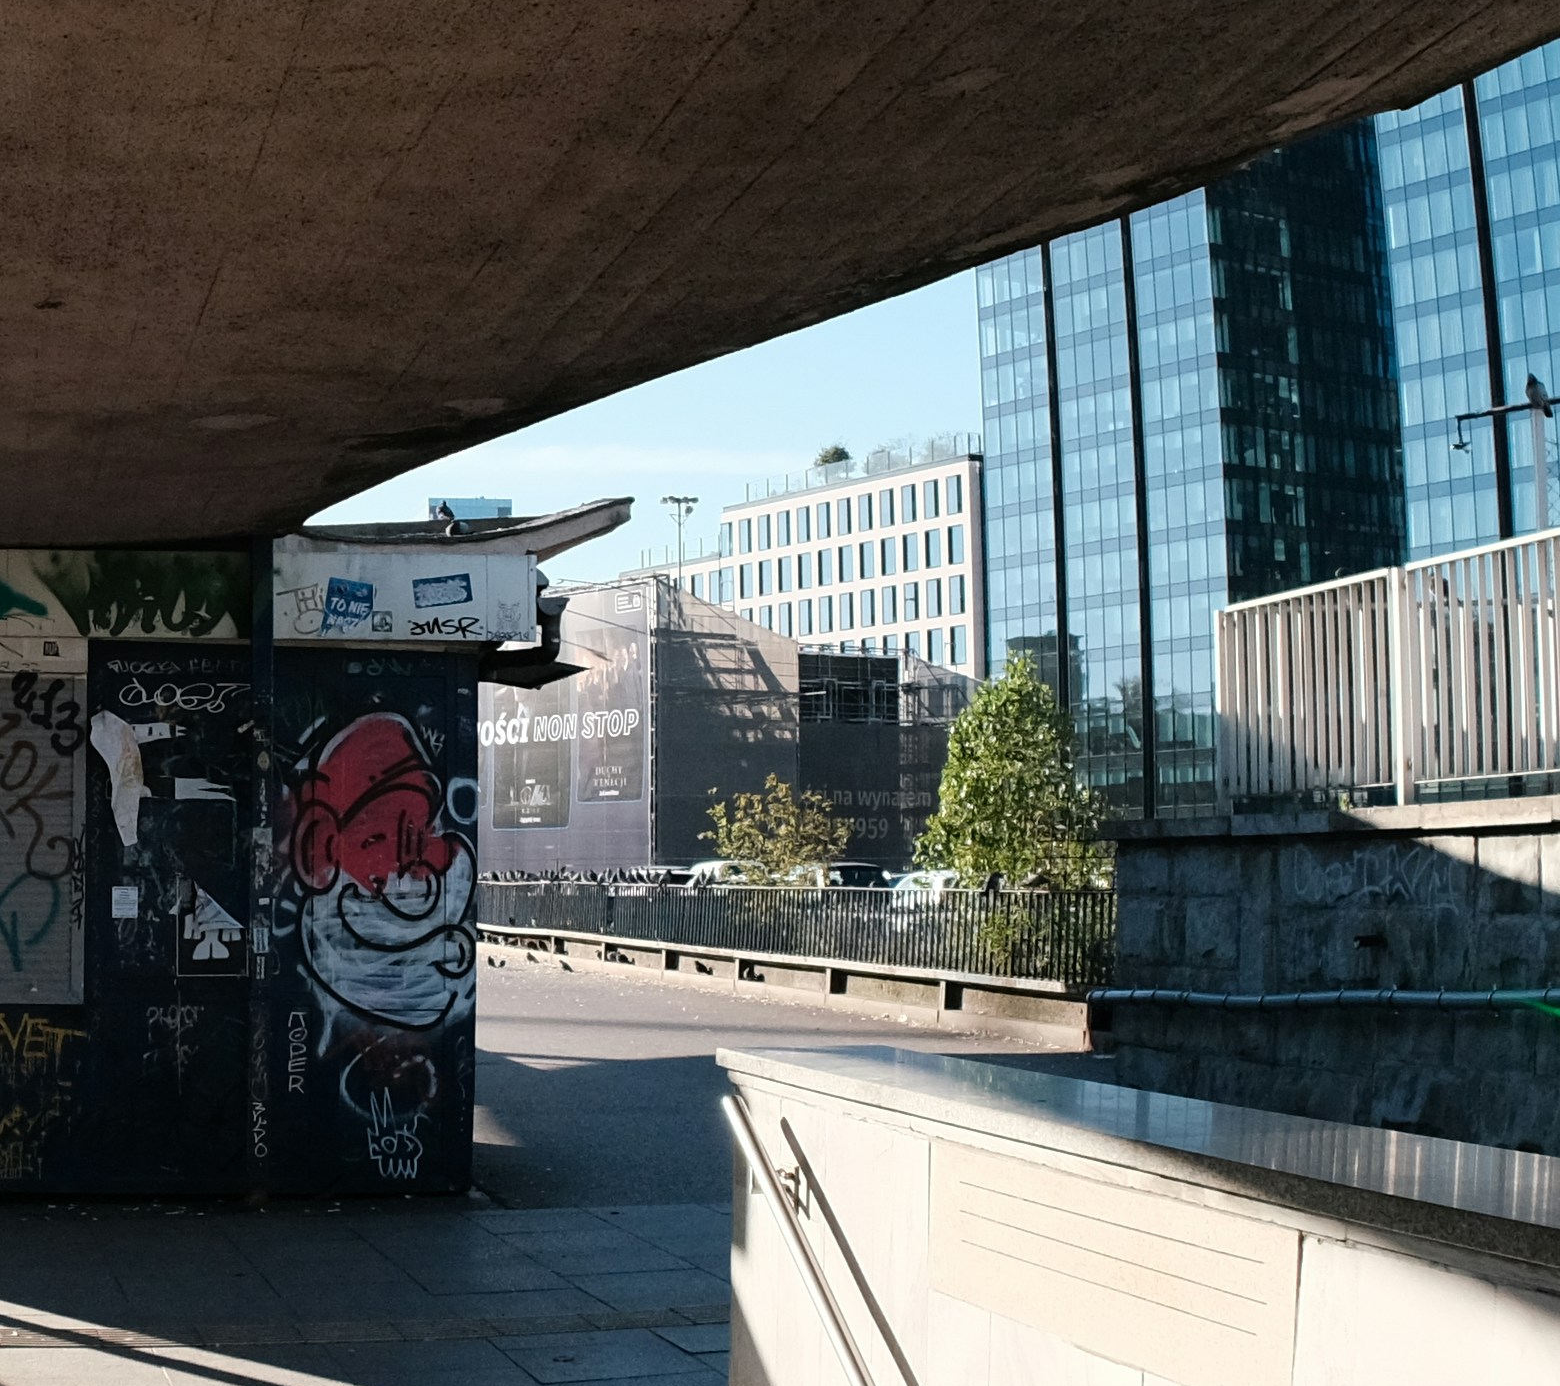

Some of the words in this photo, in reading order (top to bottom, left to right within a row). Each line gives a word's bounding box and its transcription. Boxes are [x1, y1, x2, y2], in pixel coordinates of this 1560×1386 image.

[330, 596, 347, 612] TO
[477, 711, 530, 747] OŚCI
[533, 714, 578, 742] NON
[581, 708, 640, 739] STOP
[833, 789, 853, 806] na
